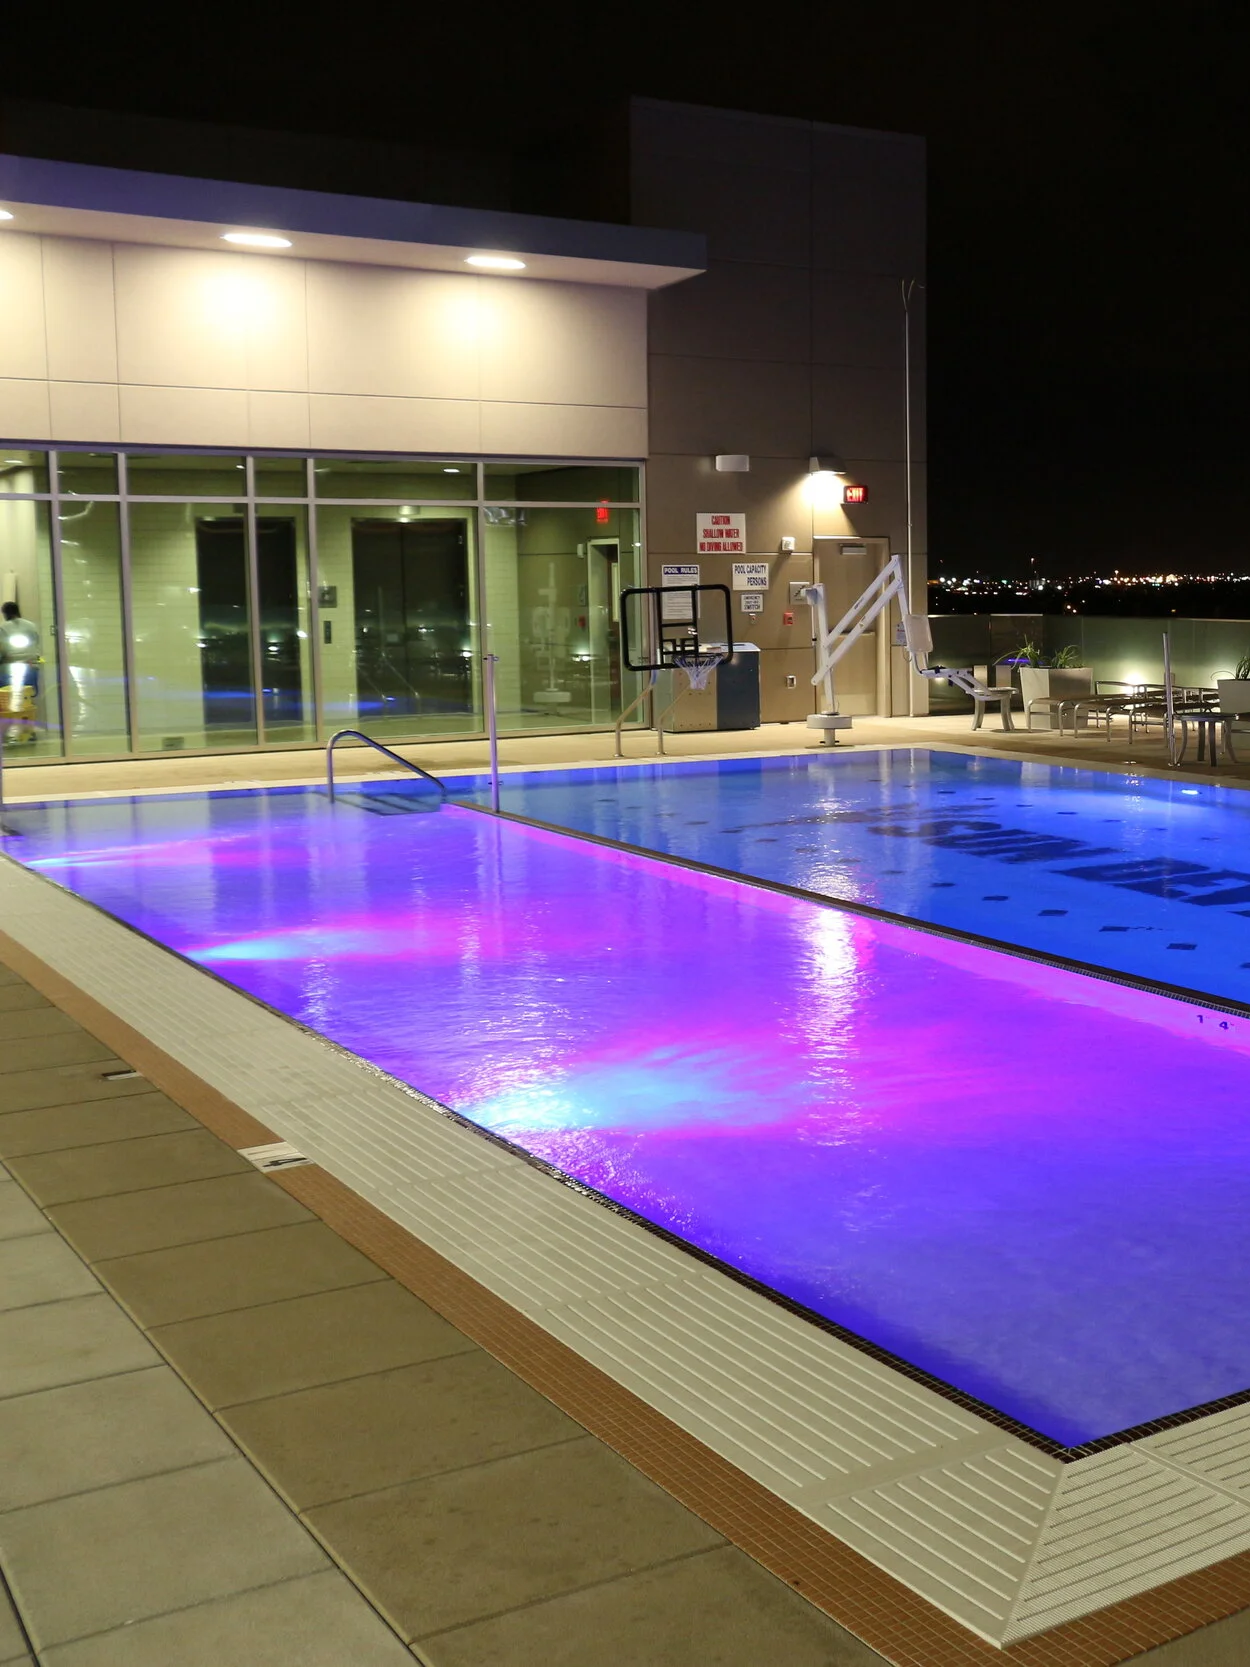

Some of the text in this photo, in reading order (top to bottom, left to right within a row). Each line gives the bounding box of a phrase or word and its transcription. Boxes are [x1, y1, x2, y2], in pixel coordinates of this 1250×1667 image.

[847, 488, 863, 501] EXIT
[712, 516, 730, 525] CAUTION
[703, 529, 740, 538] SHALLOW WATER
[699, 542, 743, 551] NO DIVING ALLOWED
[735, 565, 766, 574] POOL CAPACITY
[747, 577, 766, 586] PERSONS
[866, 820, 1128, 864] SUN
